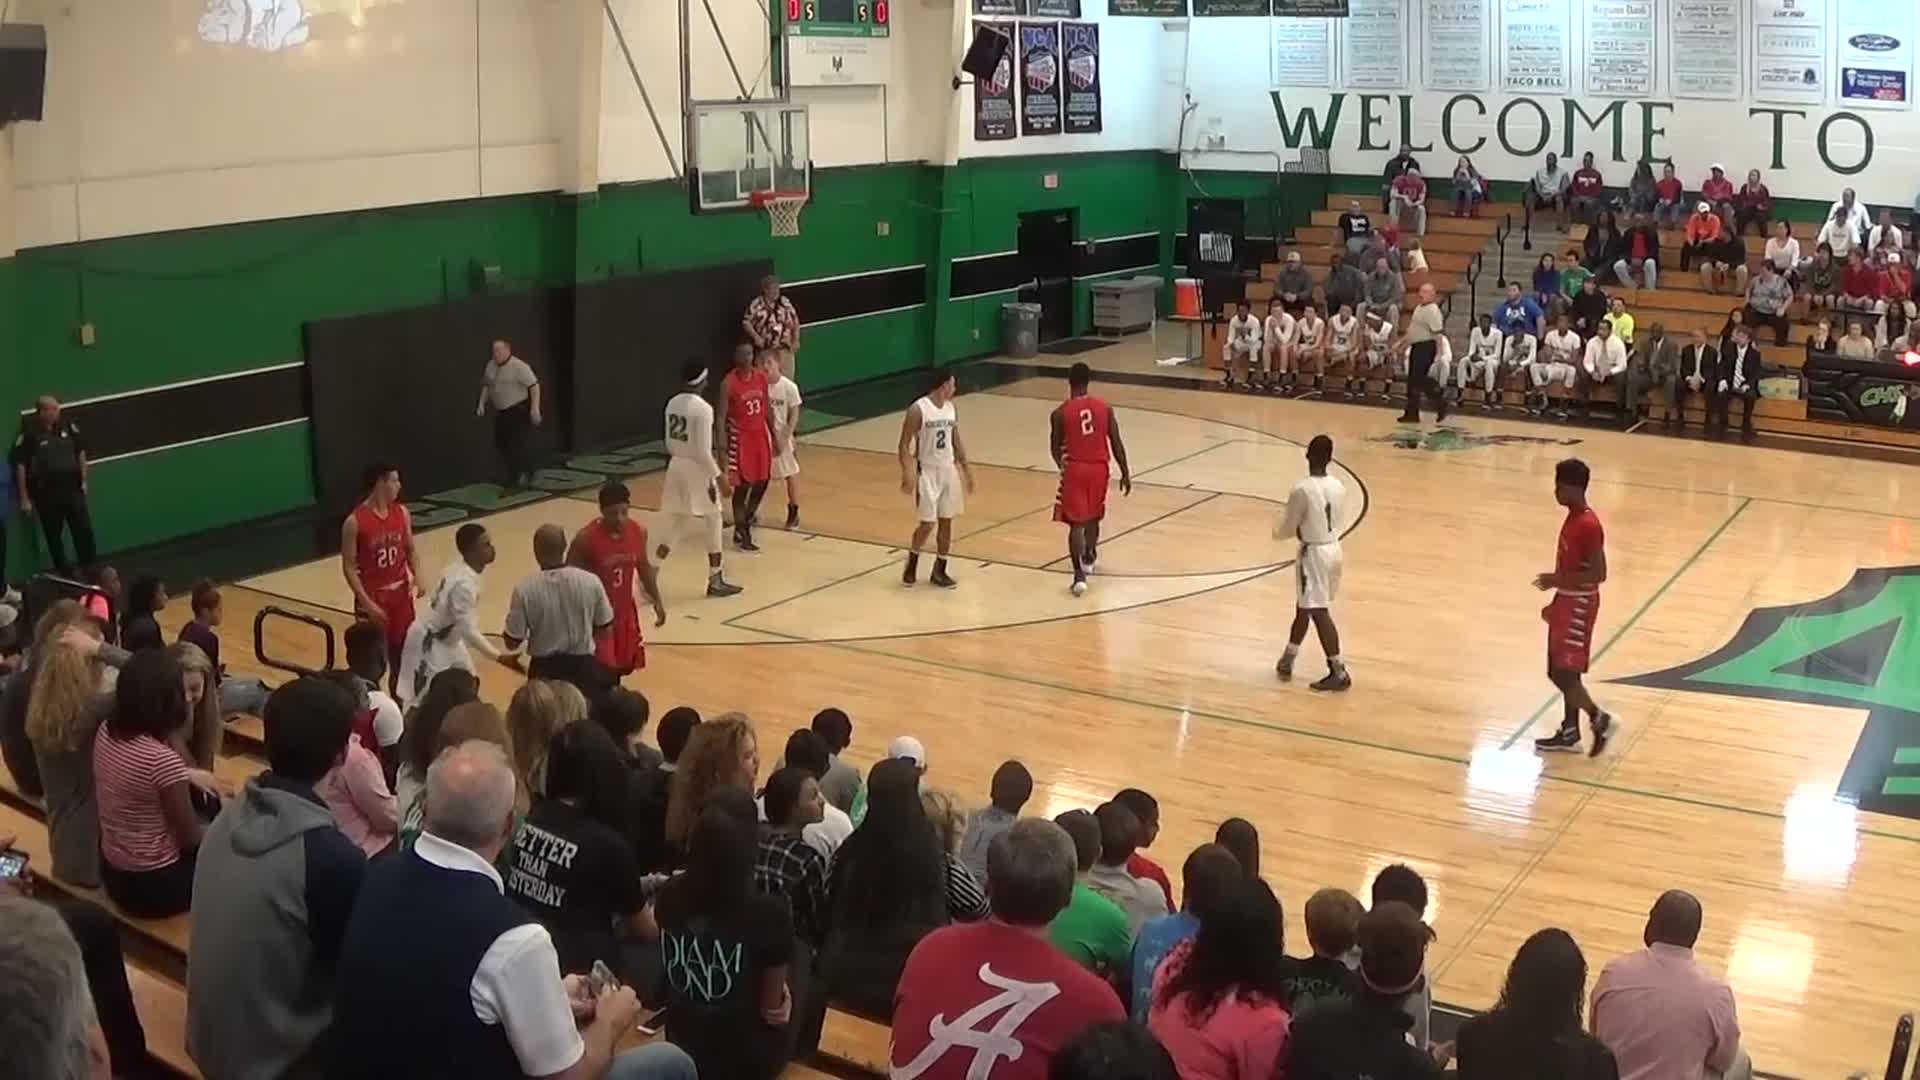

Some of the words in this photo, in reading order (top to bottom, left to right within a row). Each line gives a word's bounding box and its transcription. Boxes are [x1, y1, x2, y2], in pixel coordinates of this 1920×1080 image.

[1507, 77, 1534, 87] TACO
[1536, 78, 1562, 87] BELL
[1269, 91, 1674, 164] WELCOME
[1749, 107, 1874, 176] TO
[746, 399, 761, 416] 33
[1080, 408, 1094, 435] 2
[669, 413, 689, 442] 22
[936, 429, 946, 449] 2
[1325, 501, 1332, 533] 1
[378, 546, 398, 568] 20
[612, 567, 623, 588] 3
[514, 823, 579, 870] ETTER
[519, 850, 550, 879] THAN
[503, 865, 567, 907] STERDAY
[660, 928, 743, 974] DIAM
[889, 961, 1062, 1080] A
